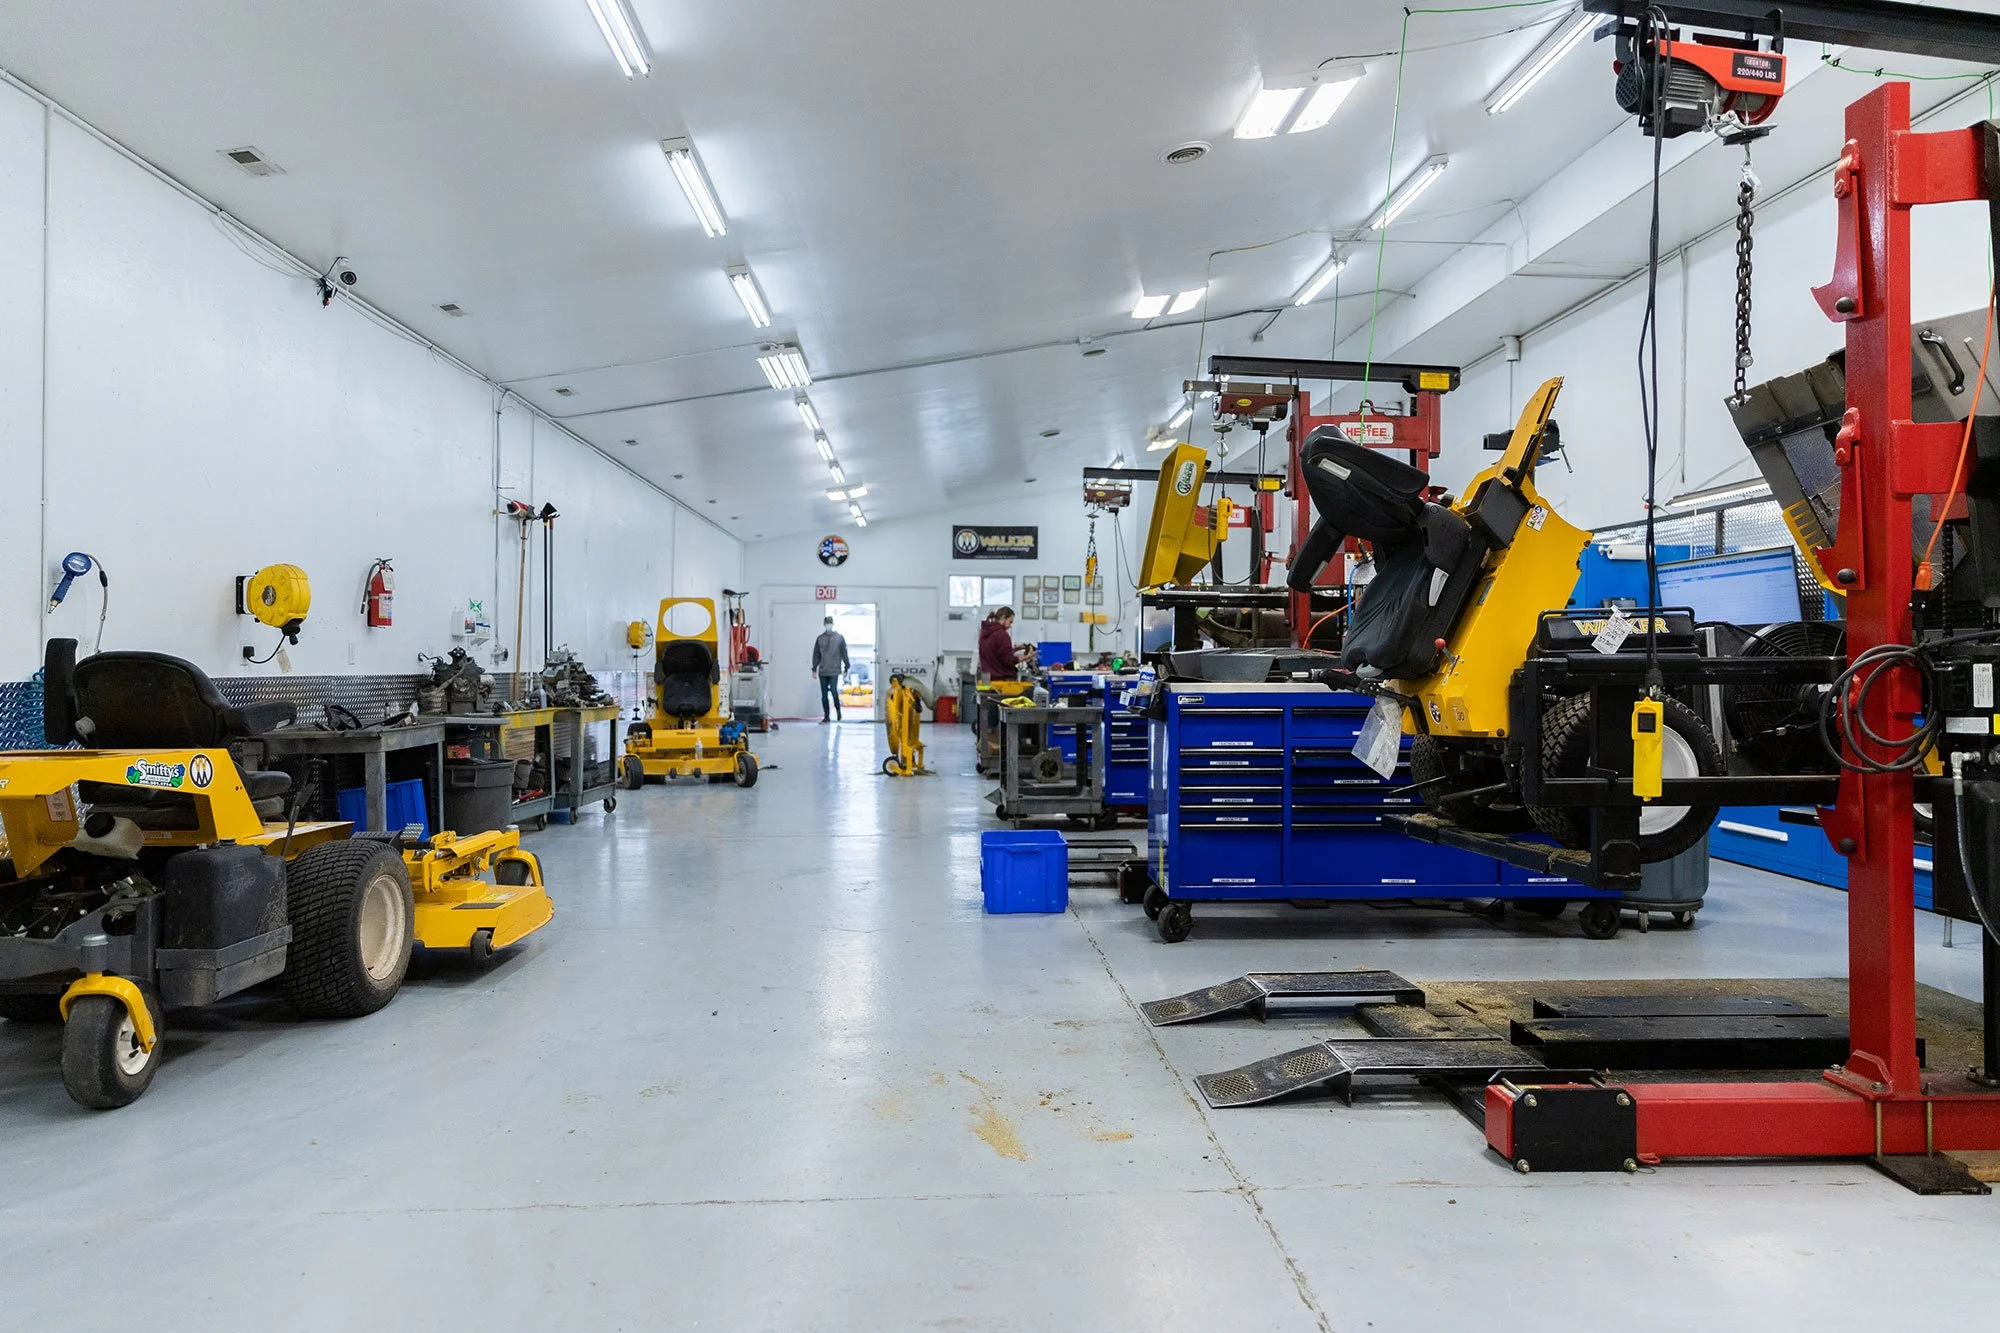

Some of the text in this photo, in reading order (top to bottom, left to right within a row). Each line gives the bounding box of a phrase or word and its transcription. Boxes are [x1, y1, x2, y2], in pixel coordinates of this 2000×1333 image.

[1737, 67, 1777, 80] 220/440 LBS
[817, 587, 836, 599] EXIT
[1573, 617, 1670, 636] WKER
[137, 759, 180, 780] Smitty's
